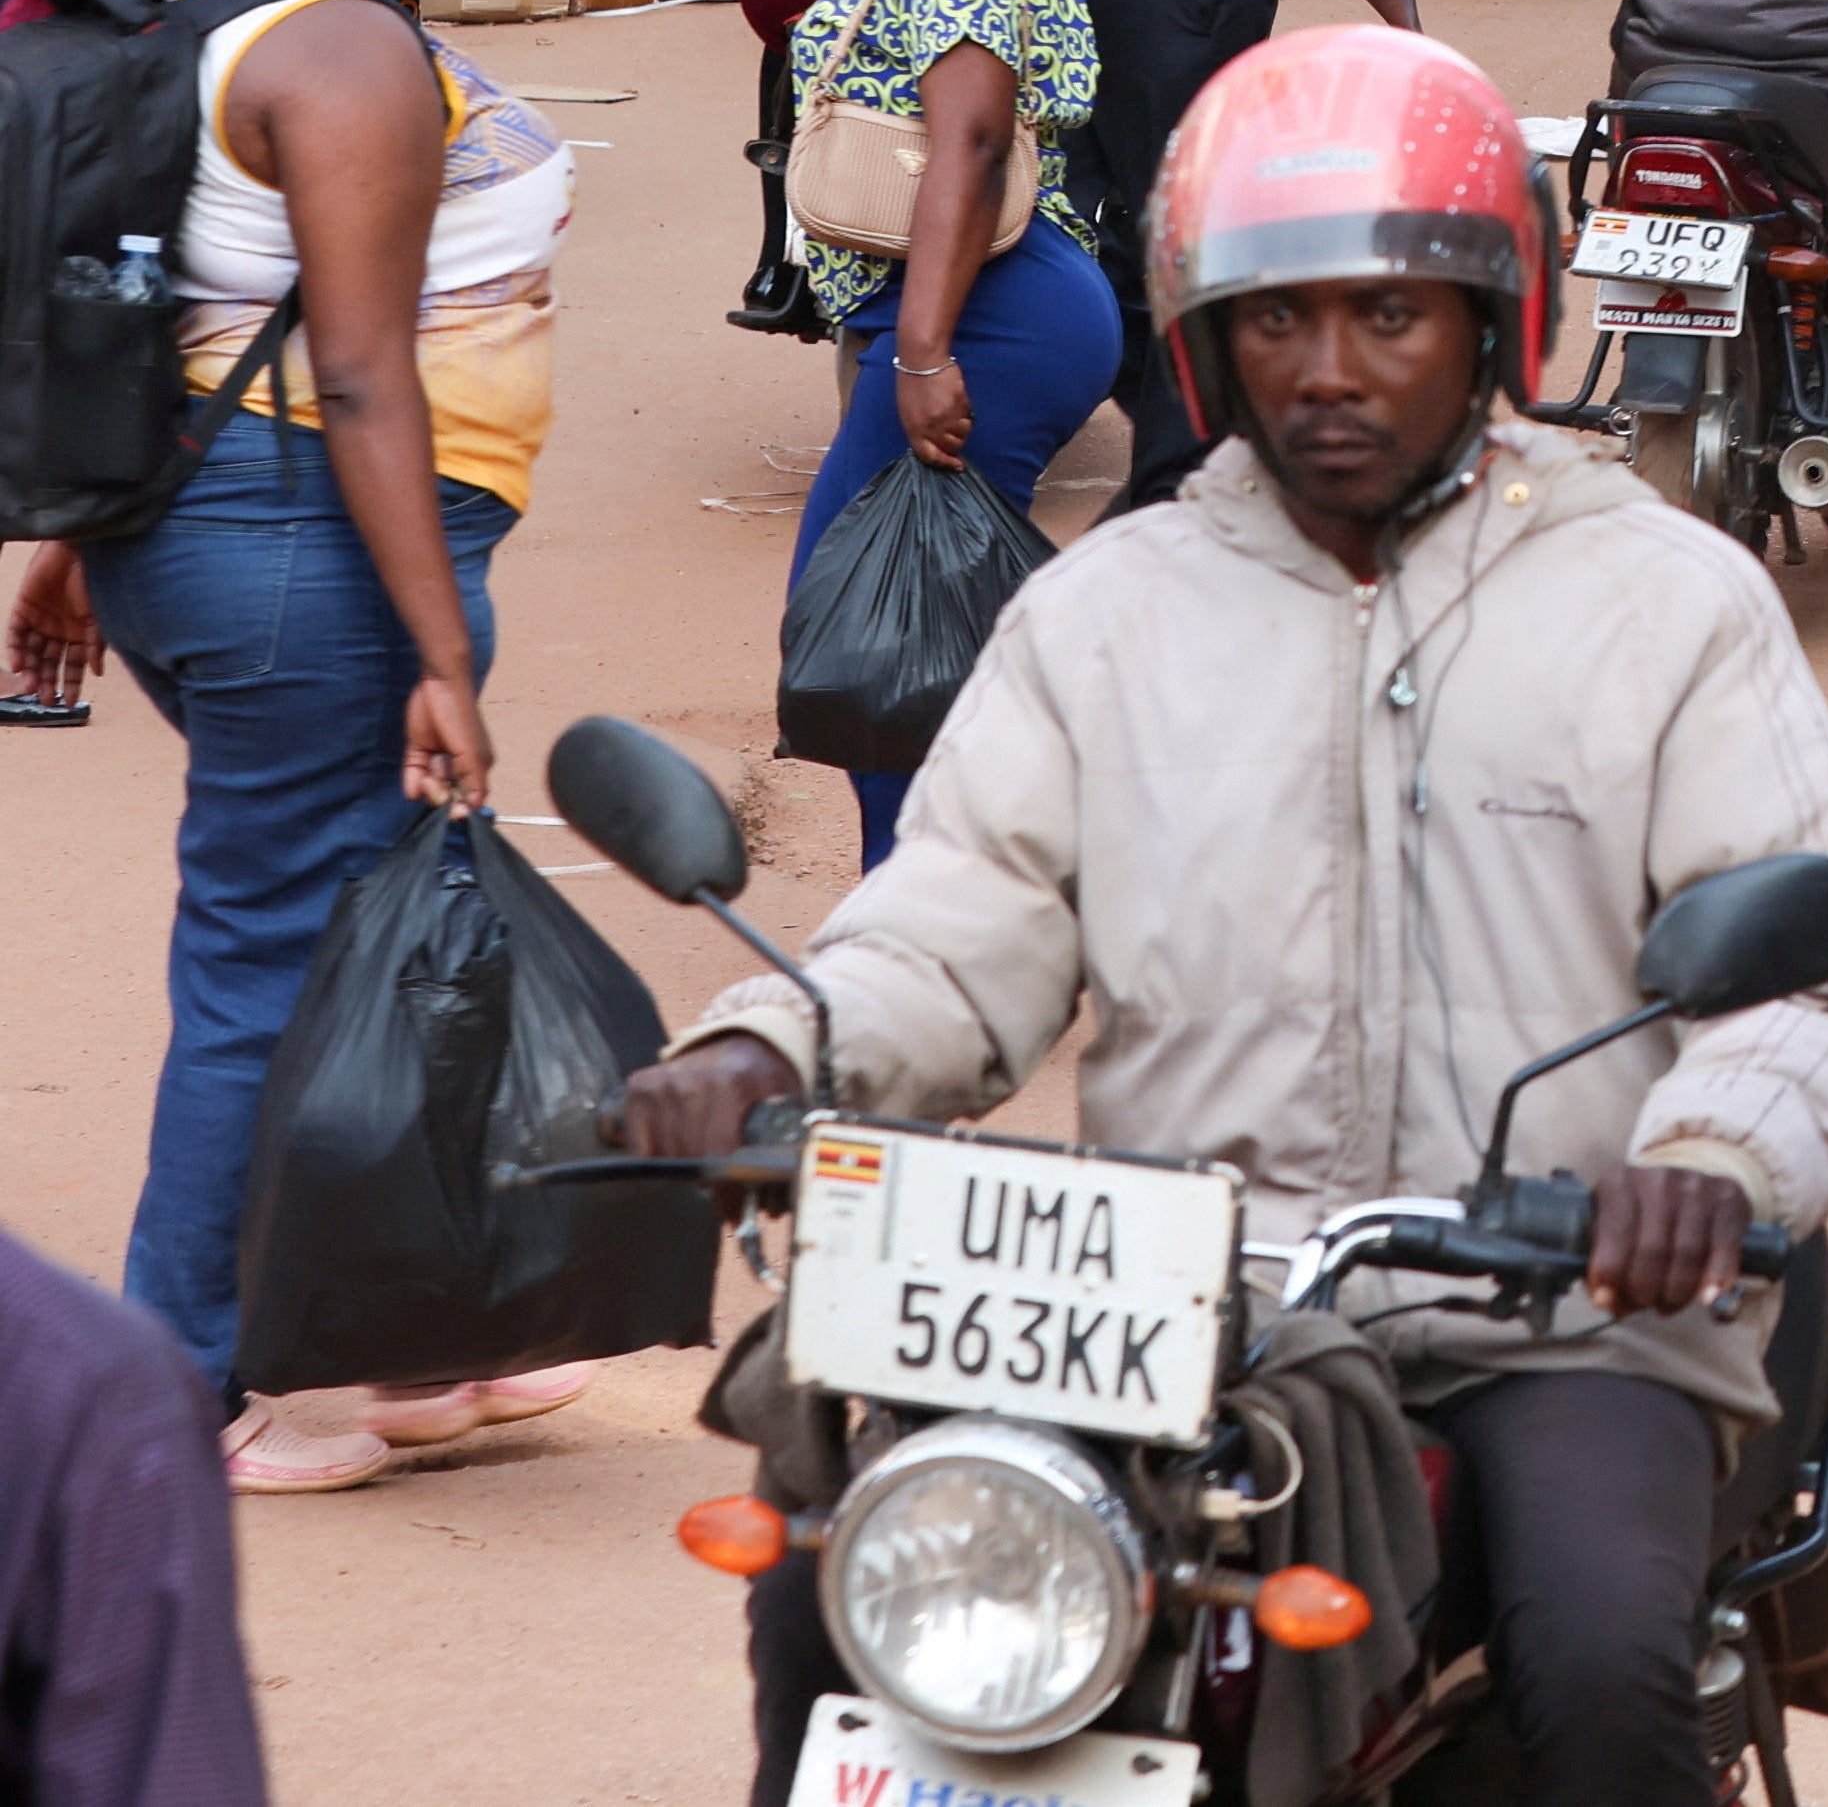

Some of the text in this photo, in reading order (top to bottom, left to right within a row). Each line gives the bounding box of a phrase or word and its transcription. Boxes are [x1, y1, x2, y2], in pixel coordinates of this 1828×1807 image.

[1648, 220, 1726, 251] UFQ
[962, 1176, 1117, 1284] UMA
[897, 1283, 1167, 1406] 563KK
